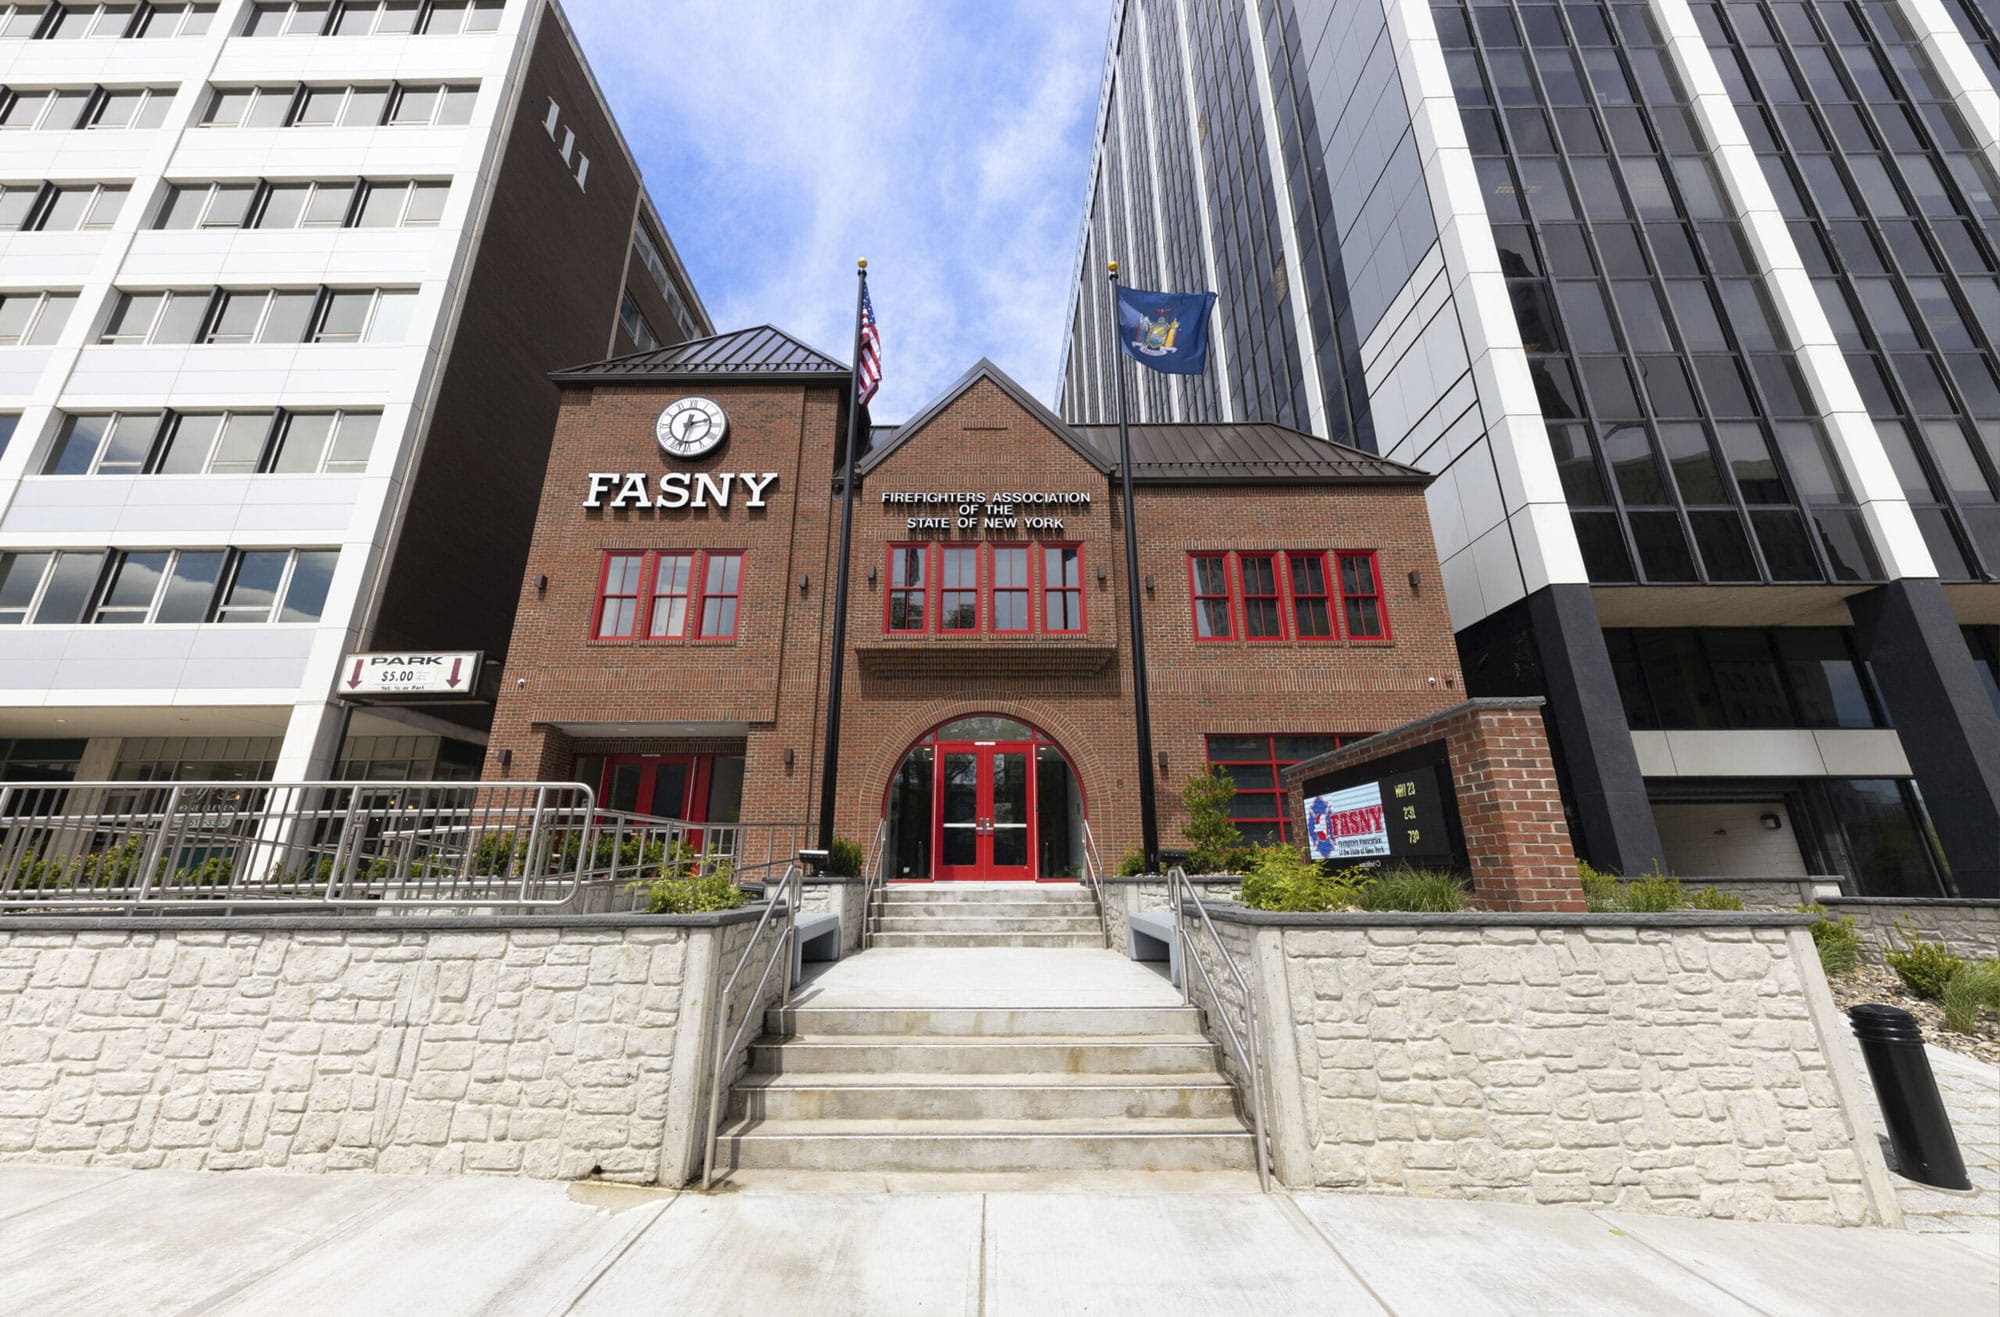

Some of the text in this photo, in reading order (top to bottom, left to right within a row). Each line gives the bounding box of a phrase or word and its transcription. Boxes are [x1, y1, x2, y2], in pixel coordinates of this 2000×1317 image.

[541, 95, 590, 194] 111
[582, 472, 778, 508] FASNY
[881, 492, 1091, 503] FIREFIGHTERS ASSOCIATION
[959, 504, 1013, 515] OF THE
[907, 517, 1064, 529] STATE OF NEW YORK
[370, 656, 444, 666] PARK
[381, 671, 414, 682] $5.00
[1406, 781, 1416, 796] 23
[1330, 805, 1383, 838] FASNY
